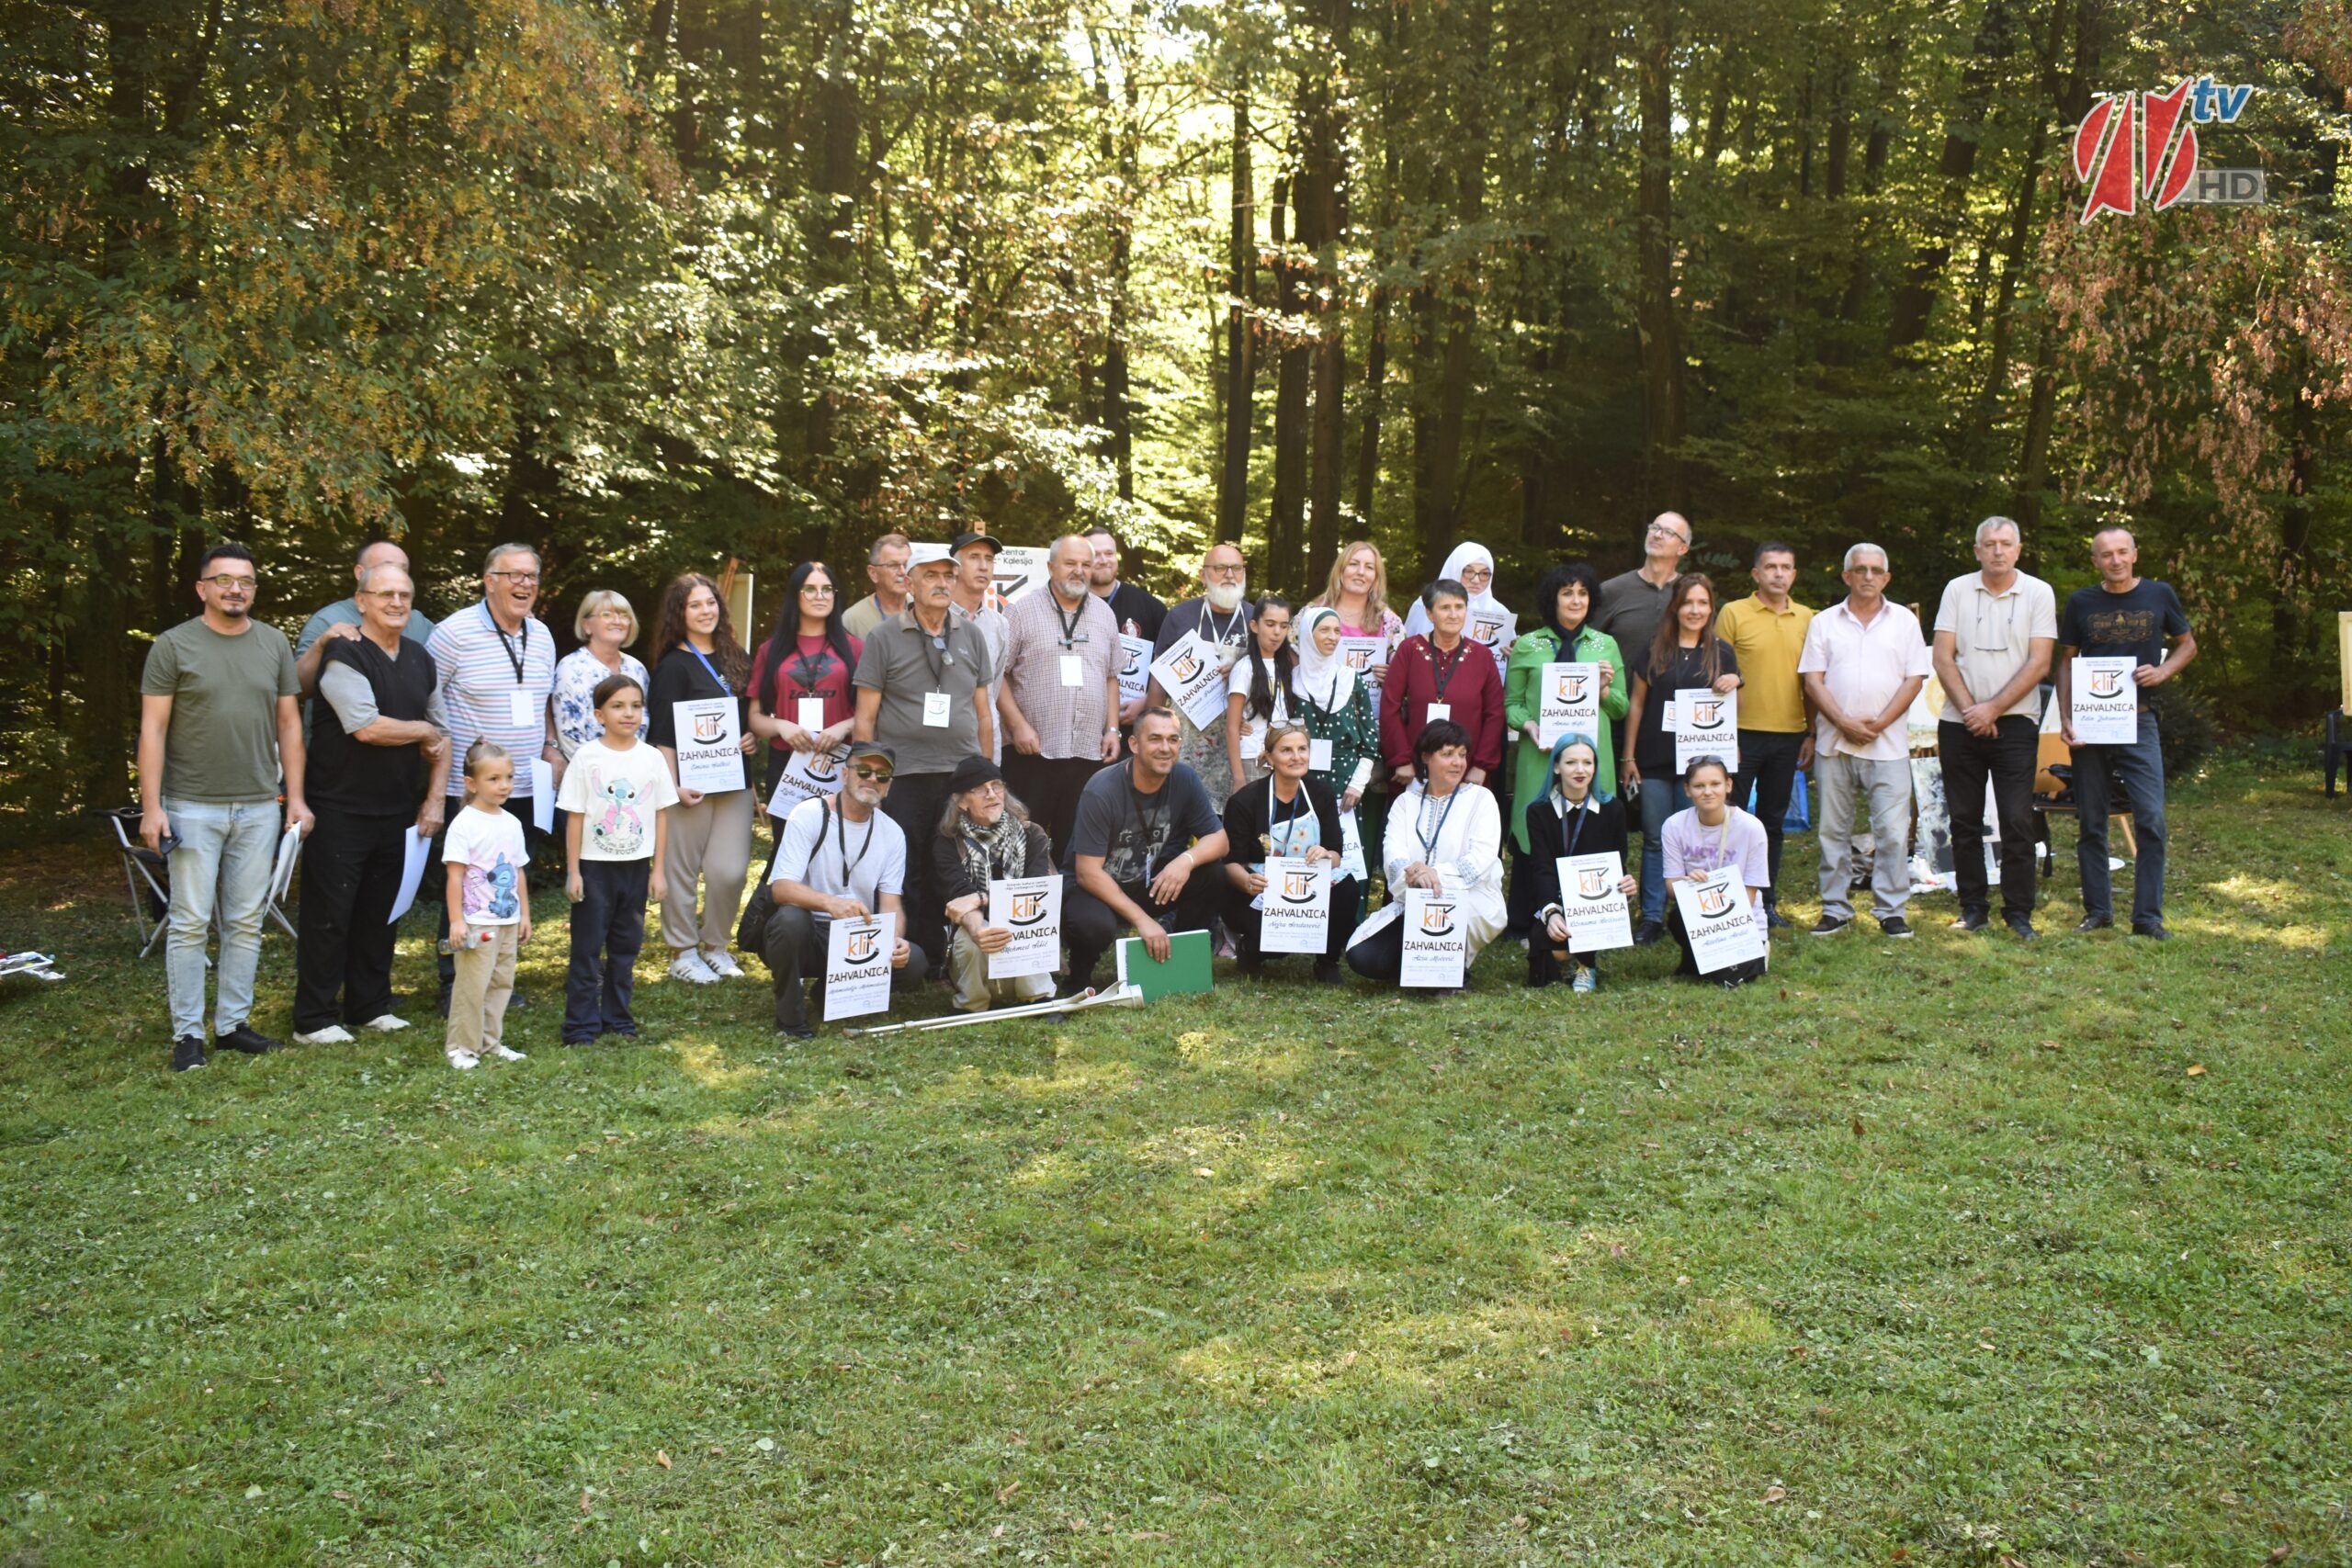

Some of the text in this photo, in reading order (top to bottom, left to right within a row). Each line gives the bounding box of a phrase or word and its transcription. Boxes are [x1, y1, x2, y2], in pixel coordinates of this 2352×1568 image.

[1003, 558, 1034, 566] Kalesija
[1117, 679, 1145, 694] ALNICA
[1178, 667, 1219, 706] ZAHVALNIC
[1542, 708, 1597, 717] ZAHVALNICA
[2074, 703, 2135, 713] ZAHVALNICA
[1678, 733, 1736, 743] ZAHVALNICA
[679, 748, 740, 761] ZAHVALNICA
[782, 773, 834, 796] ZAHVALNI
[1264, 907, 1327, 919] ZAHVALNICA
[1566, 903, 1626, 918] ZAHVALNICA
[1012, 926, 1057, 942] VALNICA
[1690, 914, 1754, 940] ZAHVALNICA
[1404, 941, 1464, 952] ZAHVALNICA
[828, 966, 889, 984] ZAHVALNICA
